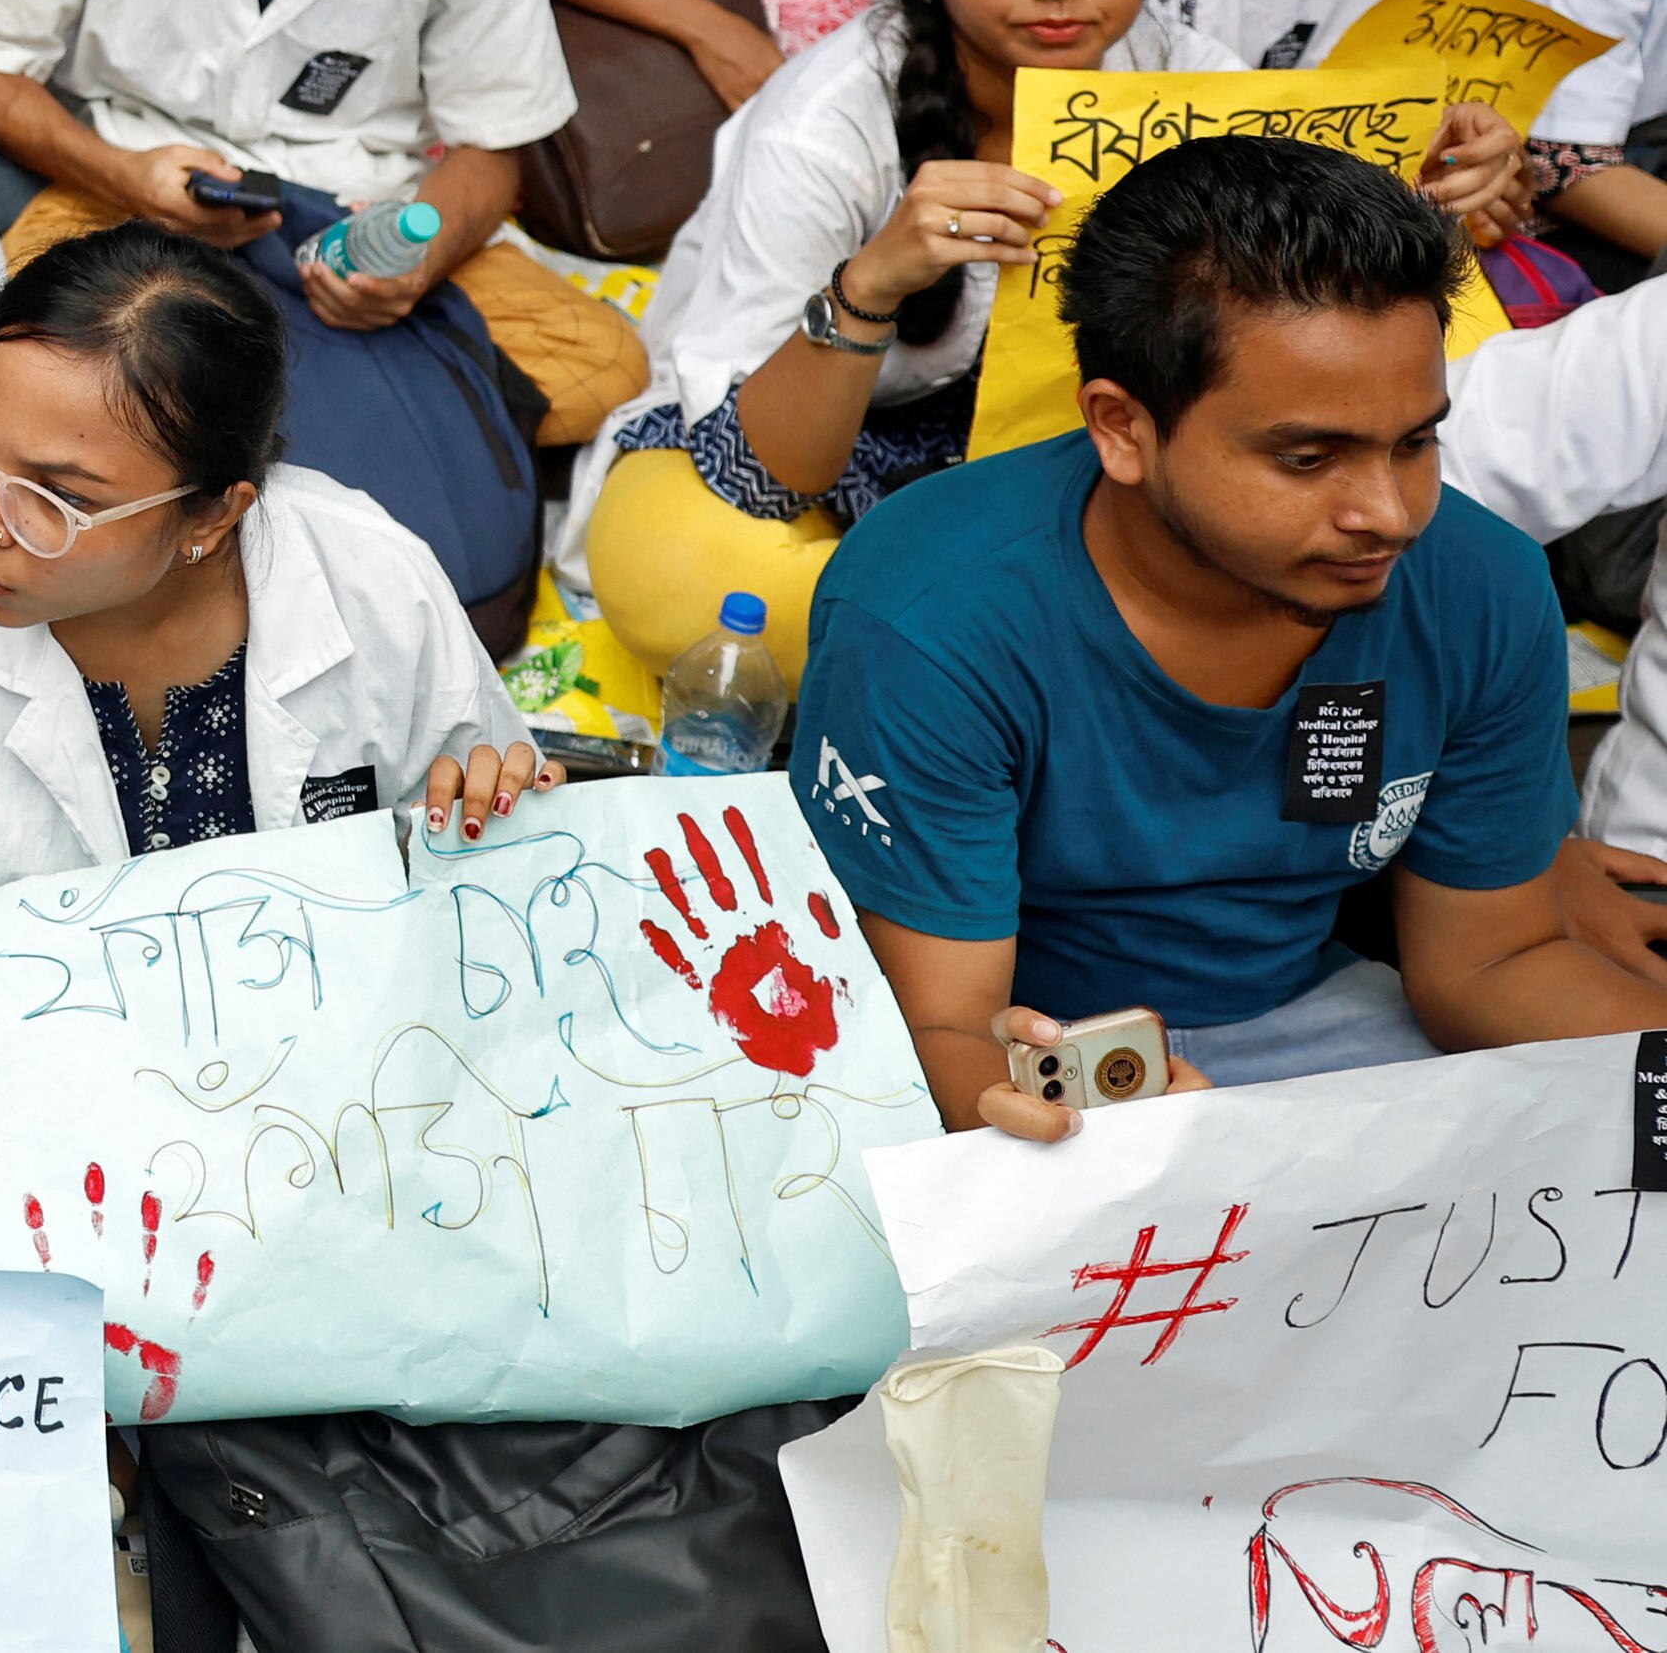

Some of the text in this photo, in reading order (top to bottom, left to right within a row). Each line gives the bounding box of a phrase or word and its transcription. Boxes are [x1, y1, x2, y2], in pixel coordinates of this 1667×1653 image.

[1318, 706, 1364, 717] RG Kar
[1297, 719, 1379, 731] Medical College
[1307, 733, 1367, 746] & Hospital
[328, 784, 369, 793] College
[314, 794, 356, 812] Hospital
[1034, 1201, 1252, 1373] #
[1477, 1341, 1667, 1471] FO
